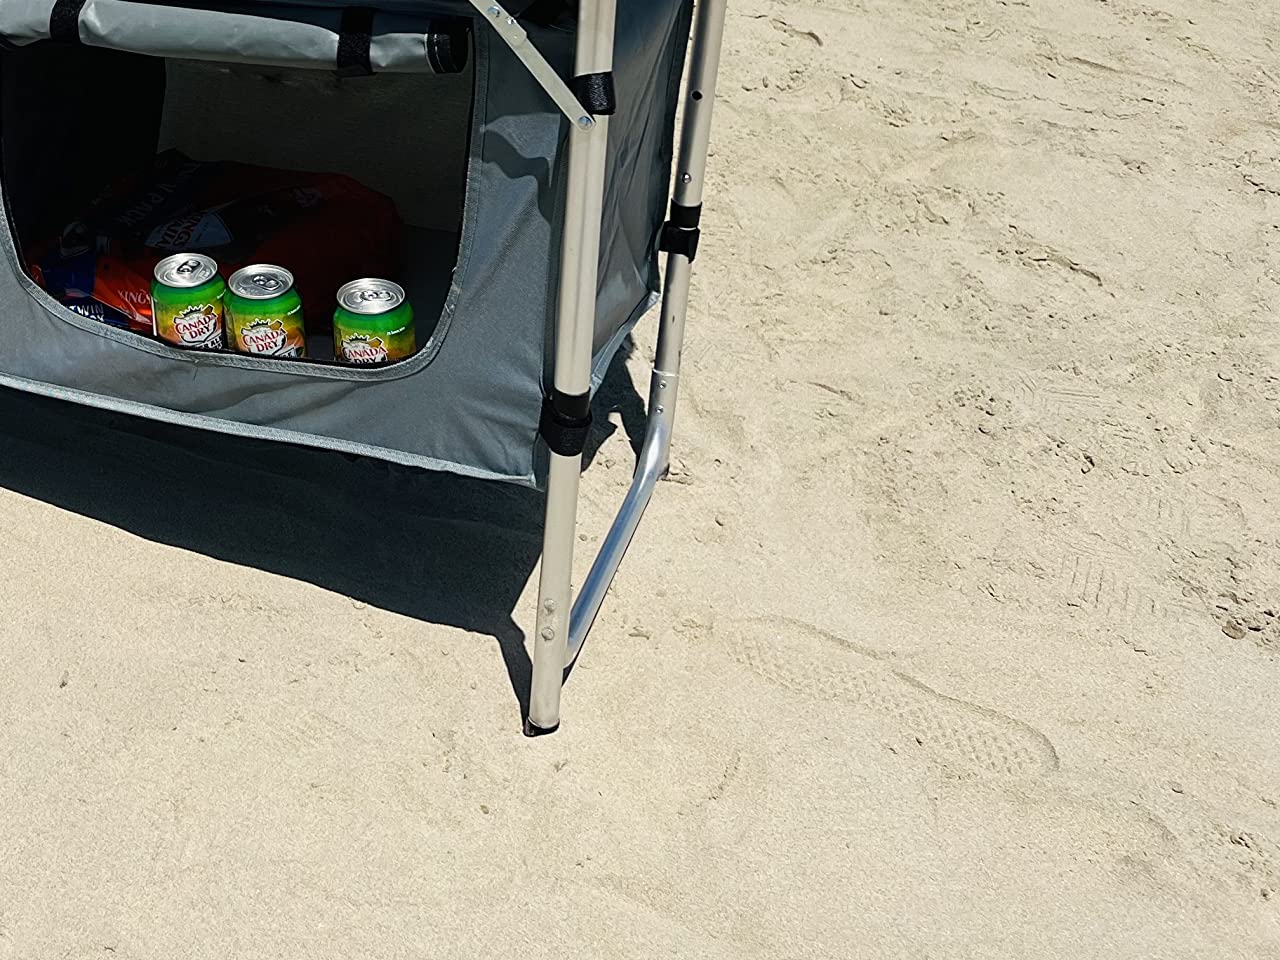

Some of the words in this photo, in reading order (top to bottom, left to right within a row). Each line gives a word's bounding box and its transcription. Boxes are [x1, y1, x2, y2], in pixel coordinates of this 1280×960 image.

[175, 313, 217, 335] CANADA
[189, 324, 211, 339] DRY
[242, 328, 286, 347] CANADA
[256, 341, 278, 353] DRY
[343, 345, 387, 361] CANADA
